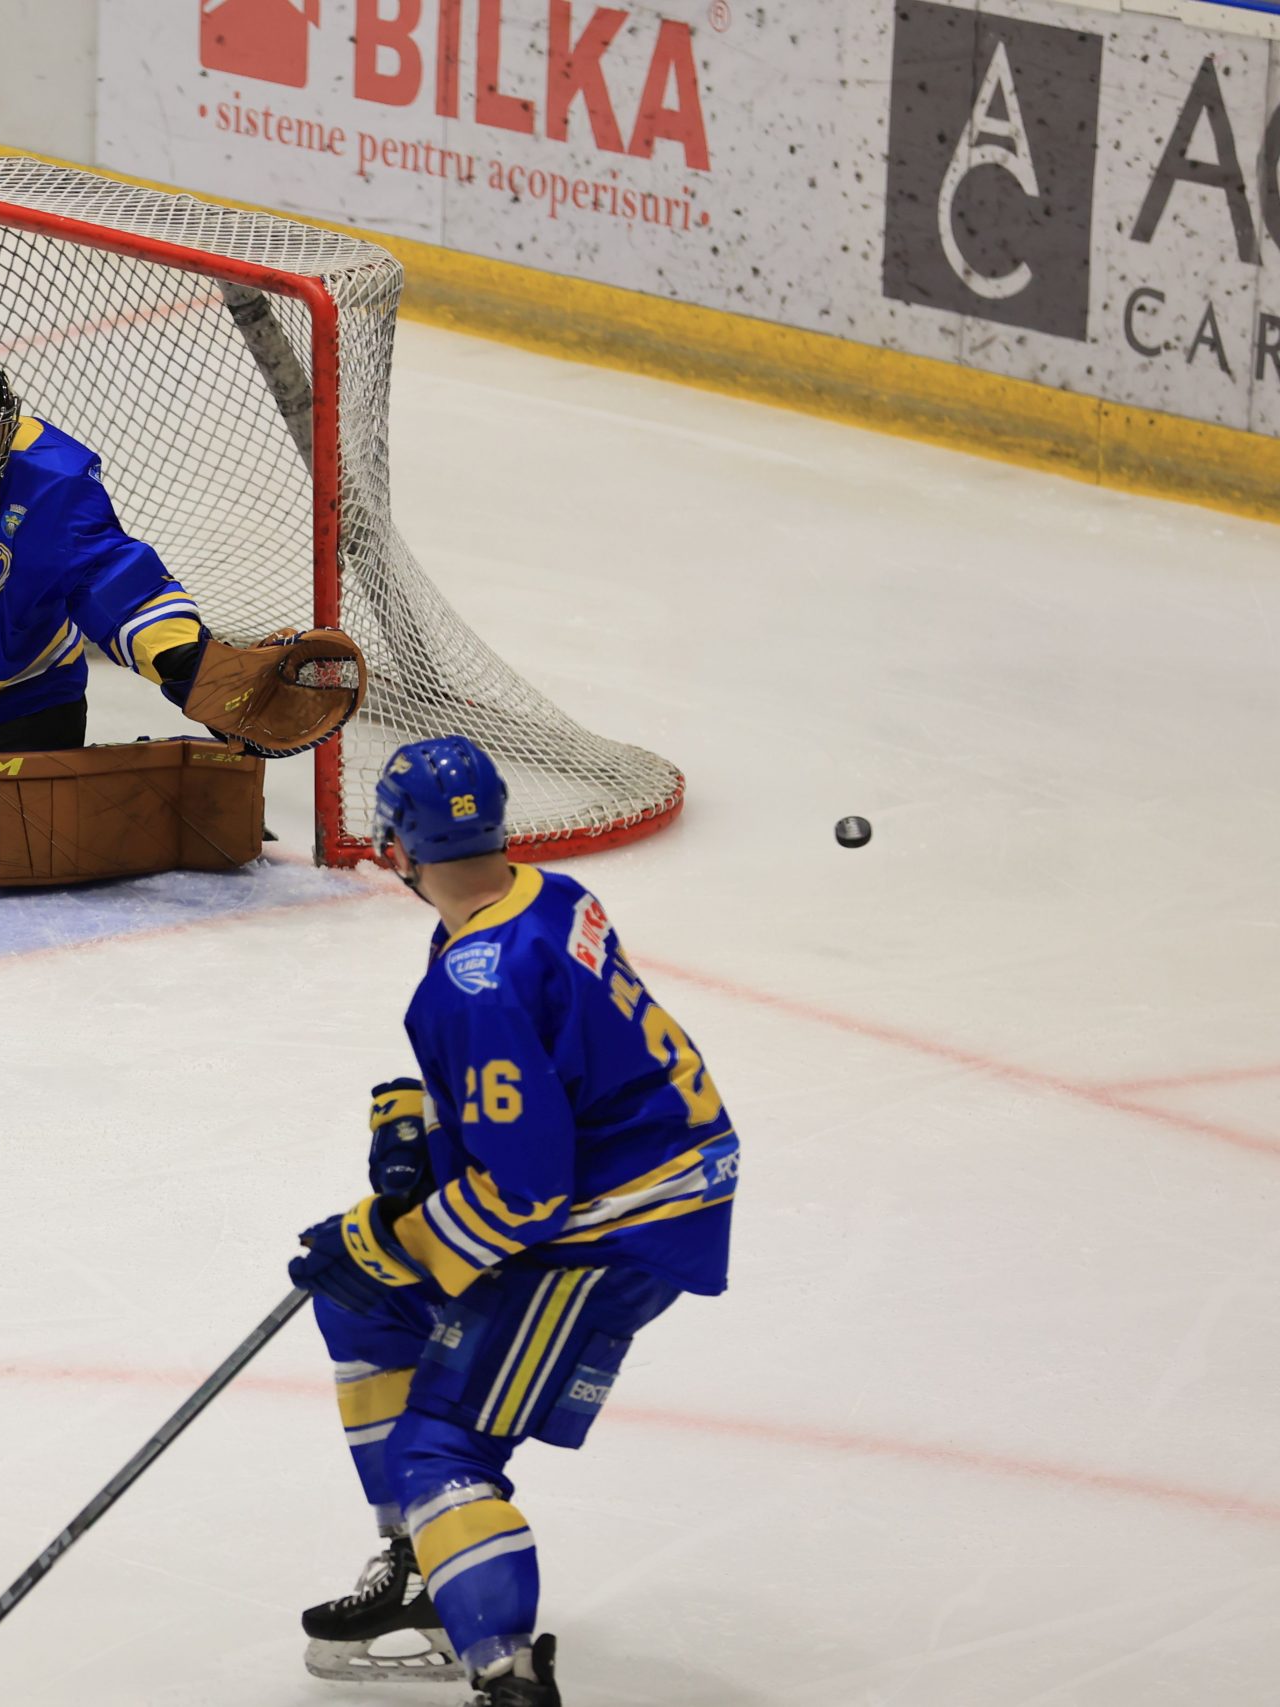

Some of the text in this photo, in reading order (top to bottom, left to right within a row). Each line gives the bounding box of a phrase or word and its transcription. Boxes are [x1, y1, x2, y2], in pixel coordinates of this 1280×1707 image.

[354, 0, 711, 172] BILKA
[215, 92, 347, 156] sisteme
[356, 126, 476, 186] pentru
[1129, 56, 1280, 267] A
[450, 794, 477, 817] 26
[456, 957, 487, 974] LIGA
